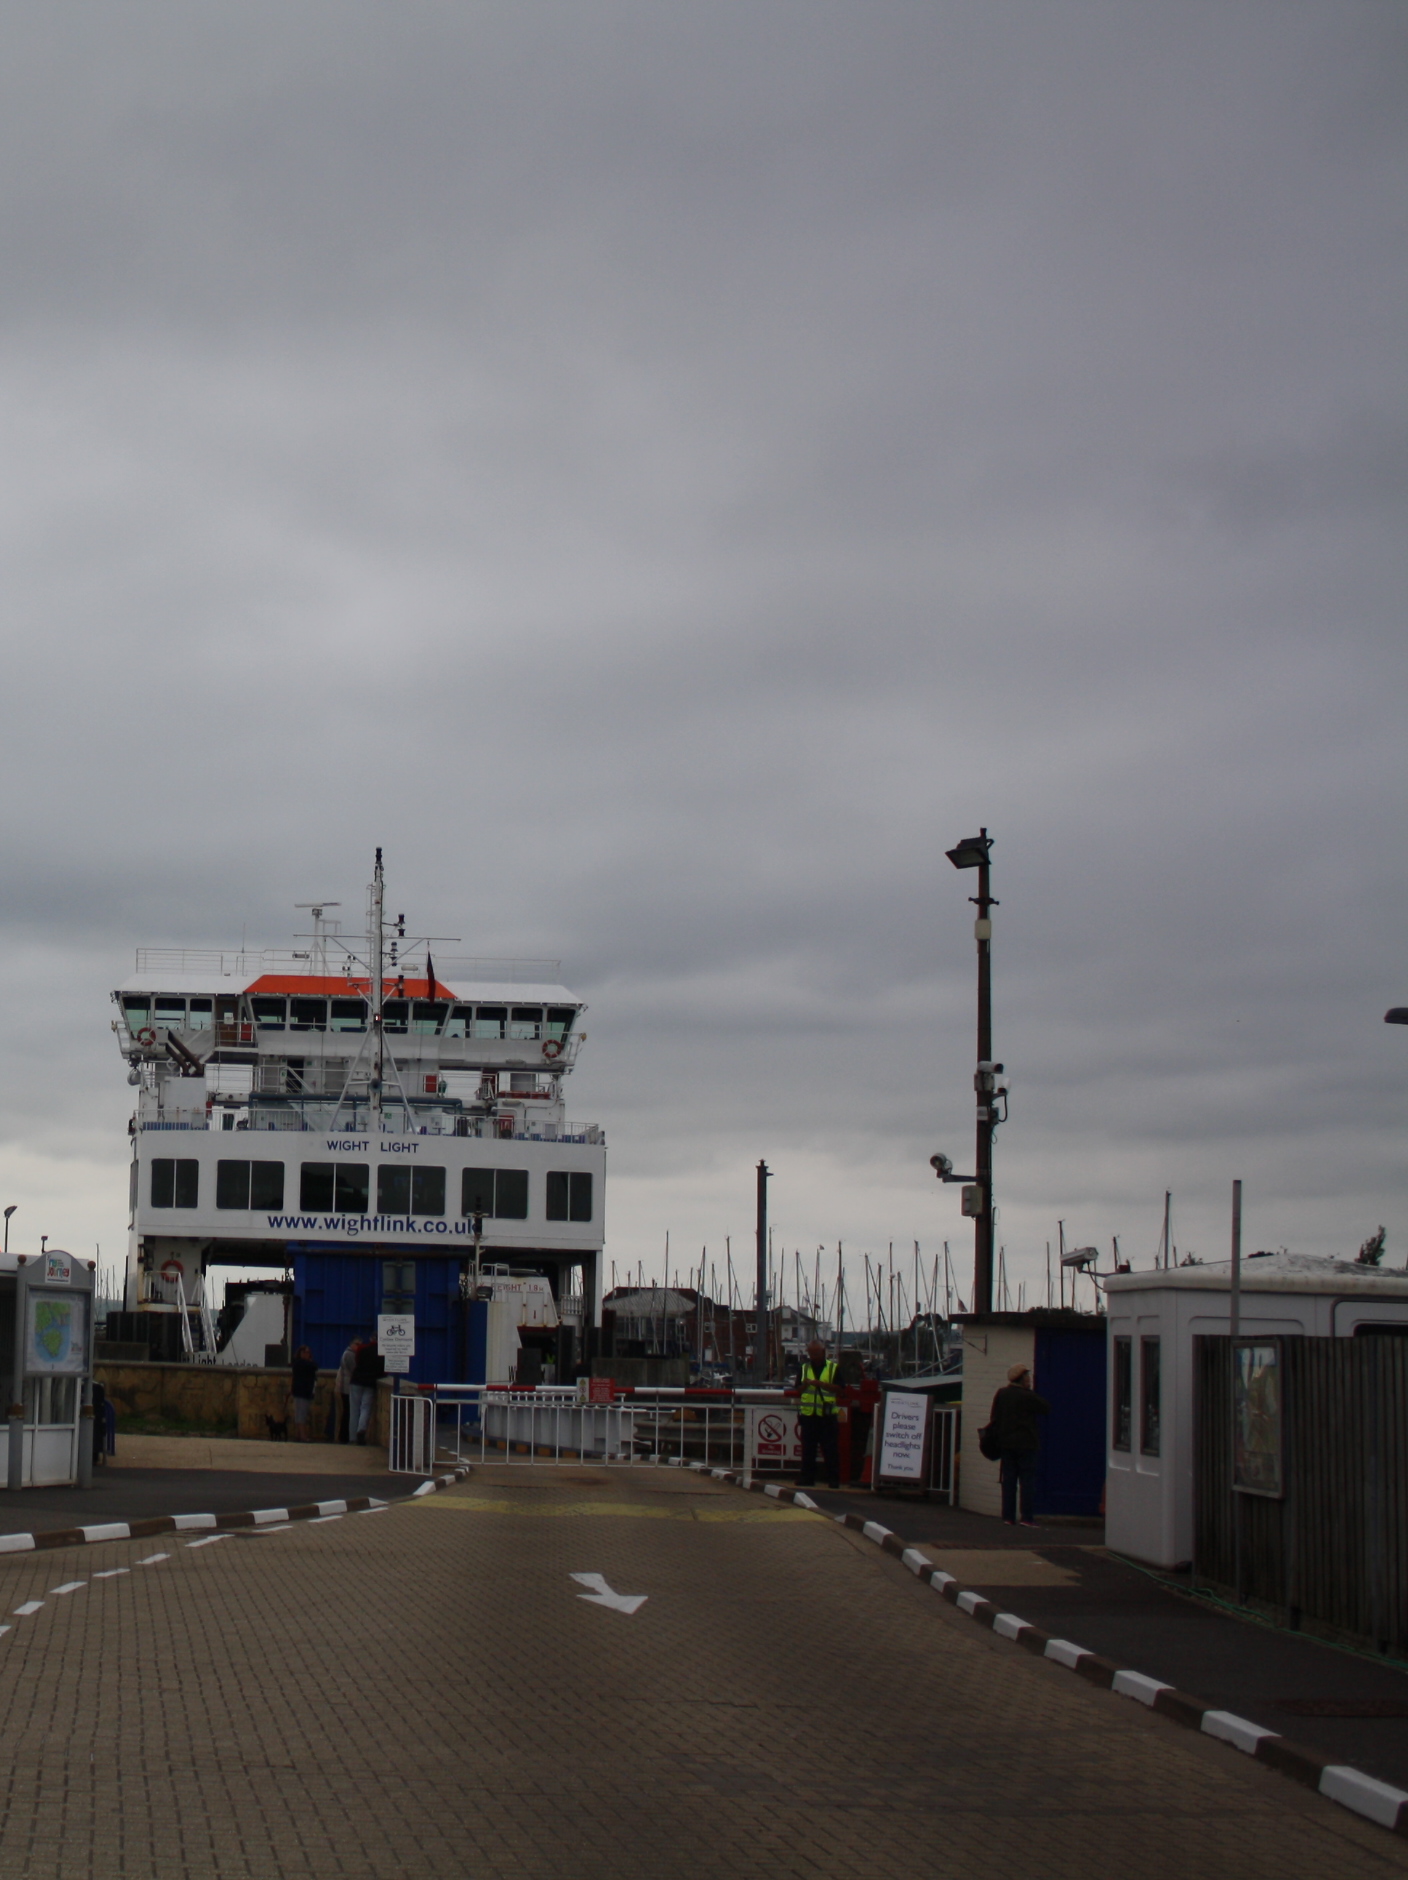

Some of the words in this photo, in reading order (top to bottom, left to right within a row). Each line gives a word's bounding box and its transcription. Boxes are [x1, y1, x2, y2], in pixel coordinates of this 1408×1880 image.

[327, 1140, 370, 1151] WIGHT
[380, 1142, 420, 1153] LIGHT
[891, 1411, 919, 1421] Drivers
[892, 1422, 916, 1431] please
[886, 1431, 910, 1439] switch
[911, 1432, 922, 1440] off
[884, 1440, 921, 1450] headlights
